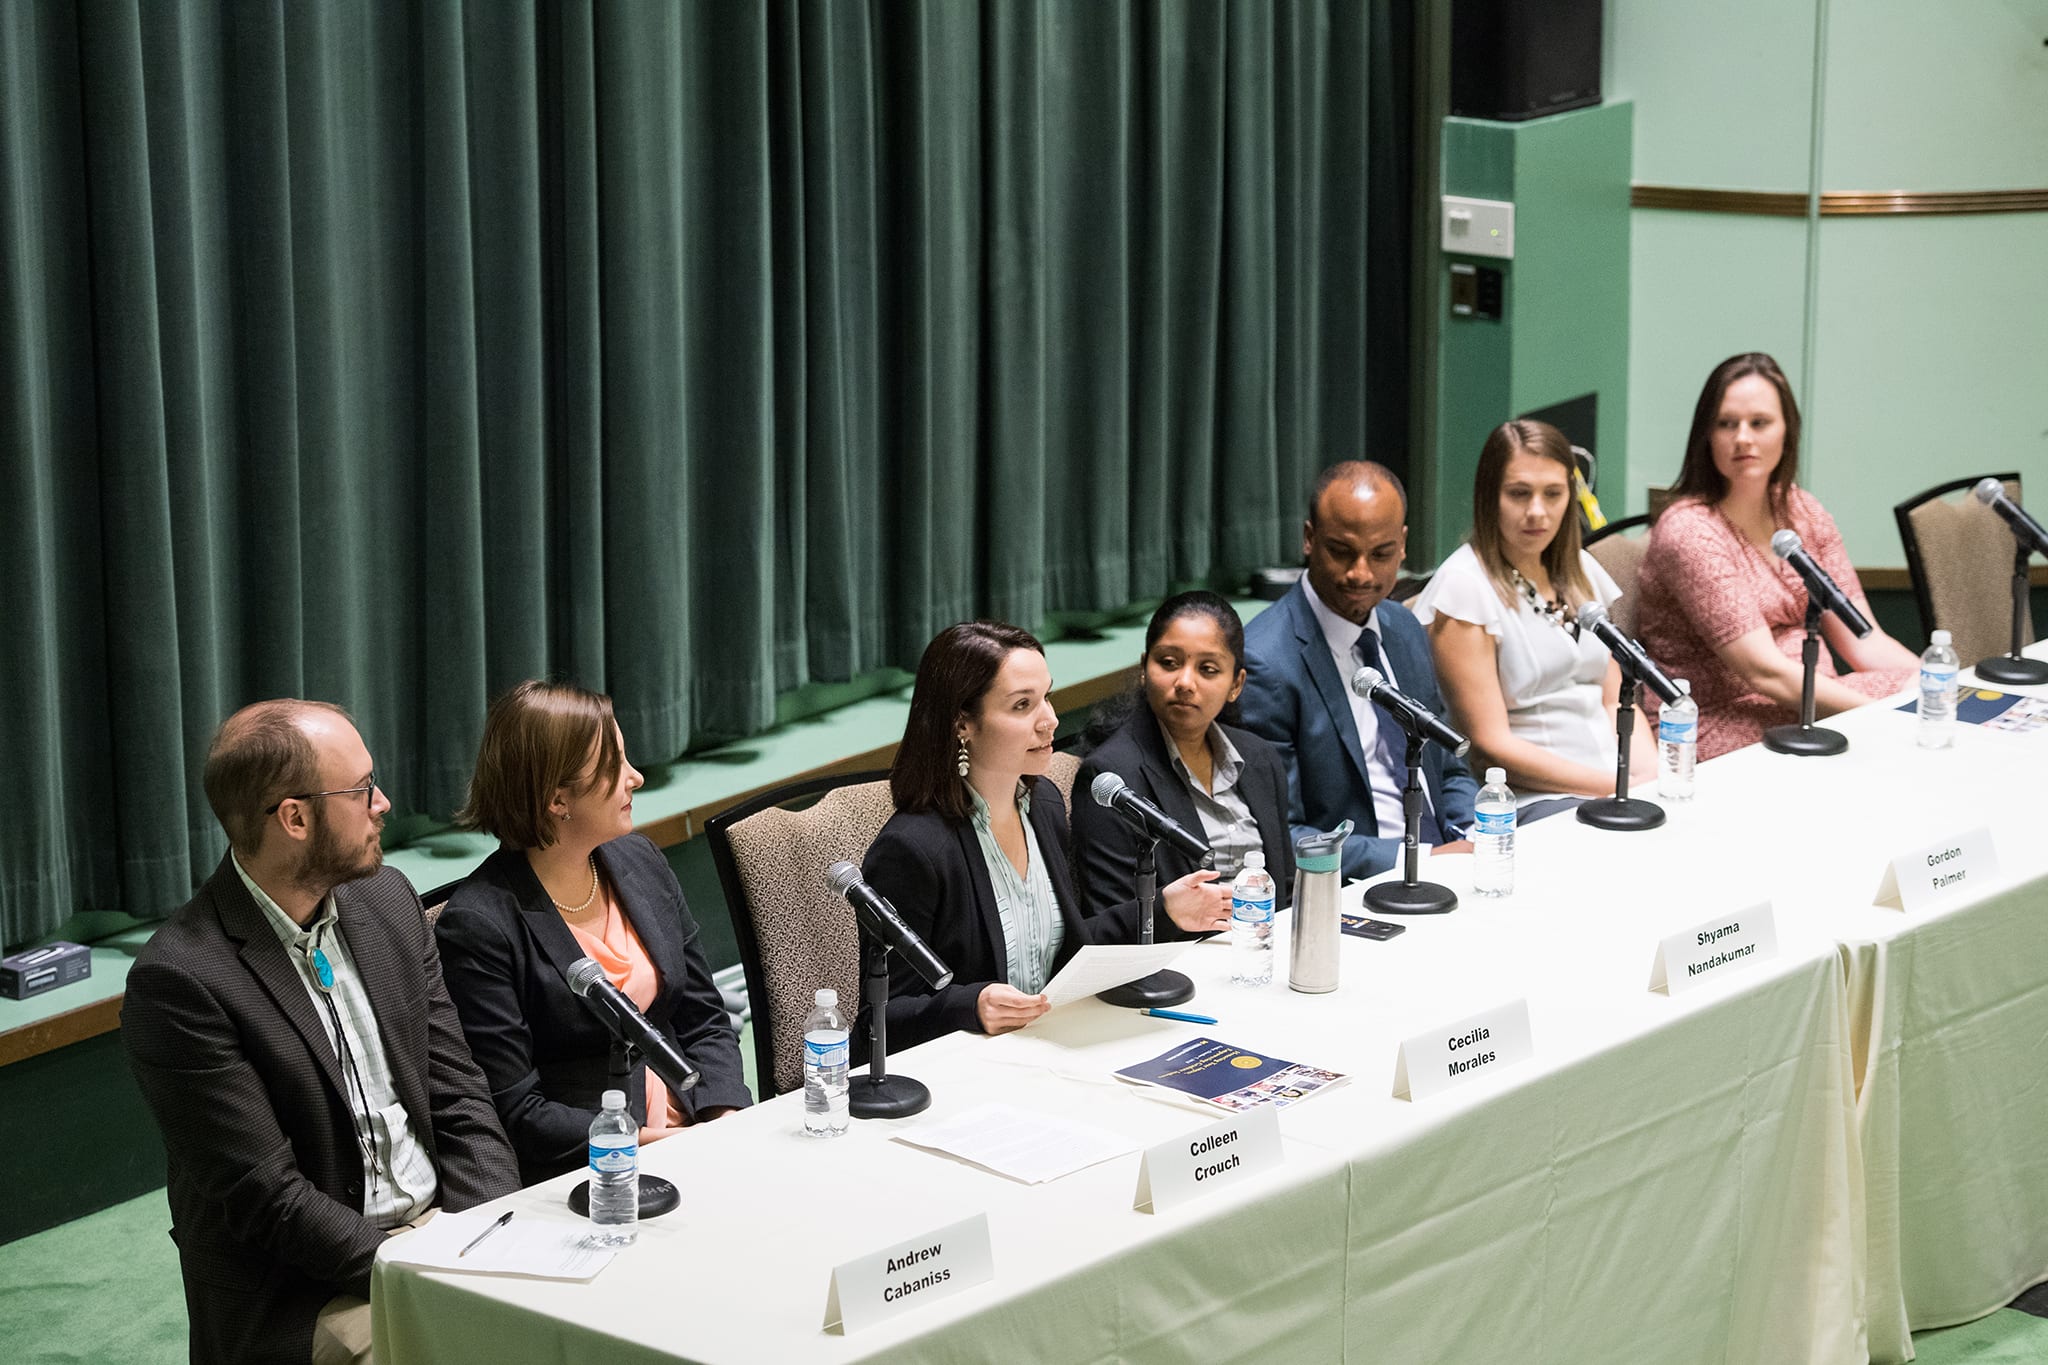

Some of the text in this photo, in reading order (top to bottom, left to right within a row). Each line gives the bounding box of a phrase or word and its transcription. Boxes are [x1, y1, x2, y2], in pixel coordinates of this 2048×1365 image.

[1927, 847, 1962, 867] Gordon
[1933, 870, 1966, 890] Palmer
[1697, 922, 1740, 946] Shyama
[1687, 943, 1756, 977] Nandakumar
[1448, 1027, 1490, 1051] Cecilia
[1448, 1050, 1496, 1077] Morales
[1190, 1129, 1239, 1157] Colleen
[1195, 1154, 1241, 1182] Crouch
[886, 1243, 942, 1274] Andrew
[883, 1268, 951, 1303] Cabaniss
